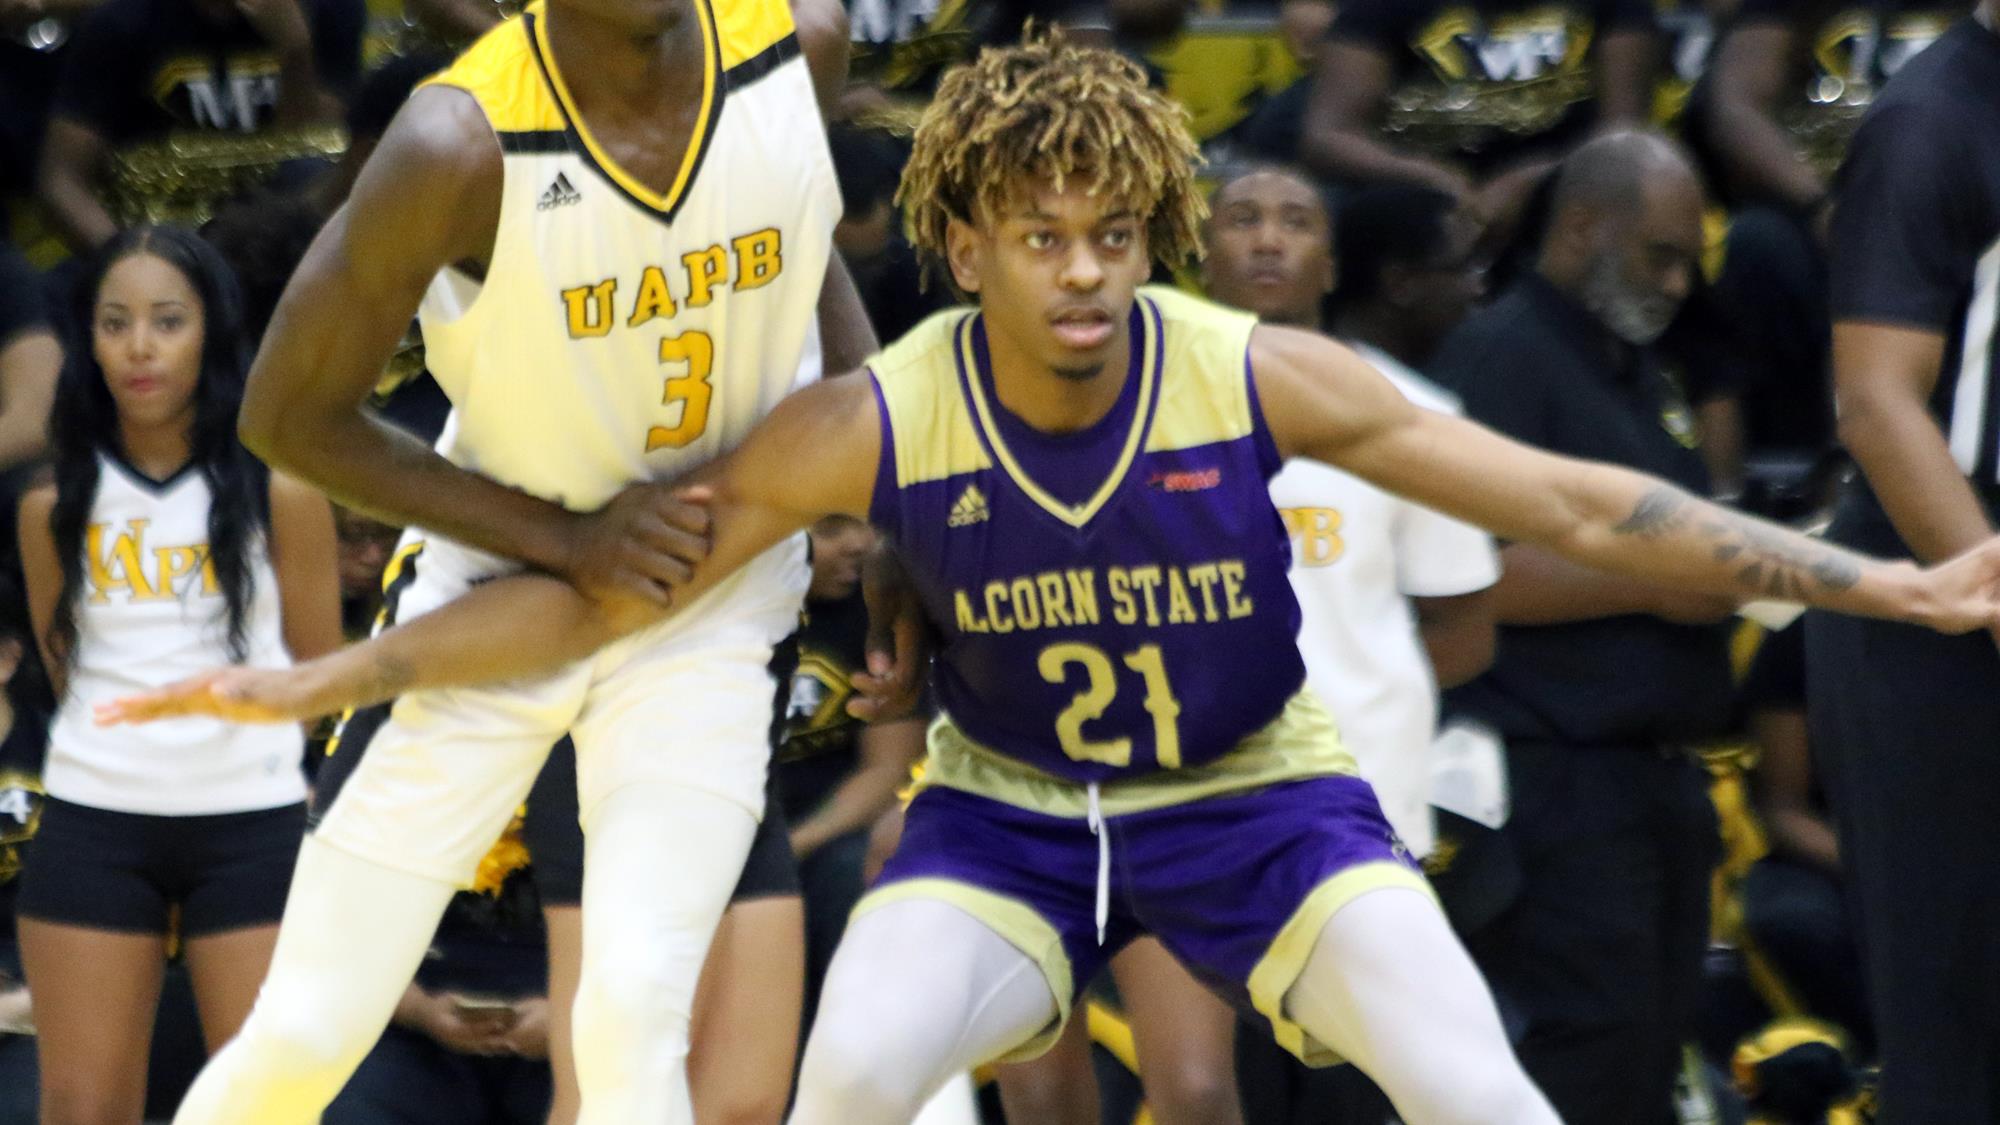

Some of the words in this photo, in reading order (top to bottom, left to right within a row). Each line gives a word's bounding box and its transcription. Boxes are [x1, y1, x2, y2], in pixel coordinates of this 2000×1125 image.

[561, 227, 782, 339] UAPB
[646, 330, 713, 453] 3
[1108, 560, 1254, 627] STATE
[1037, 642, 1181, 769] 21
